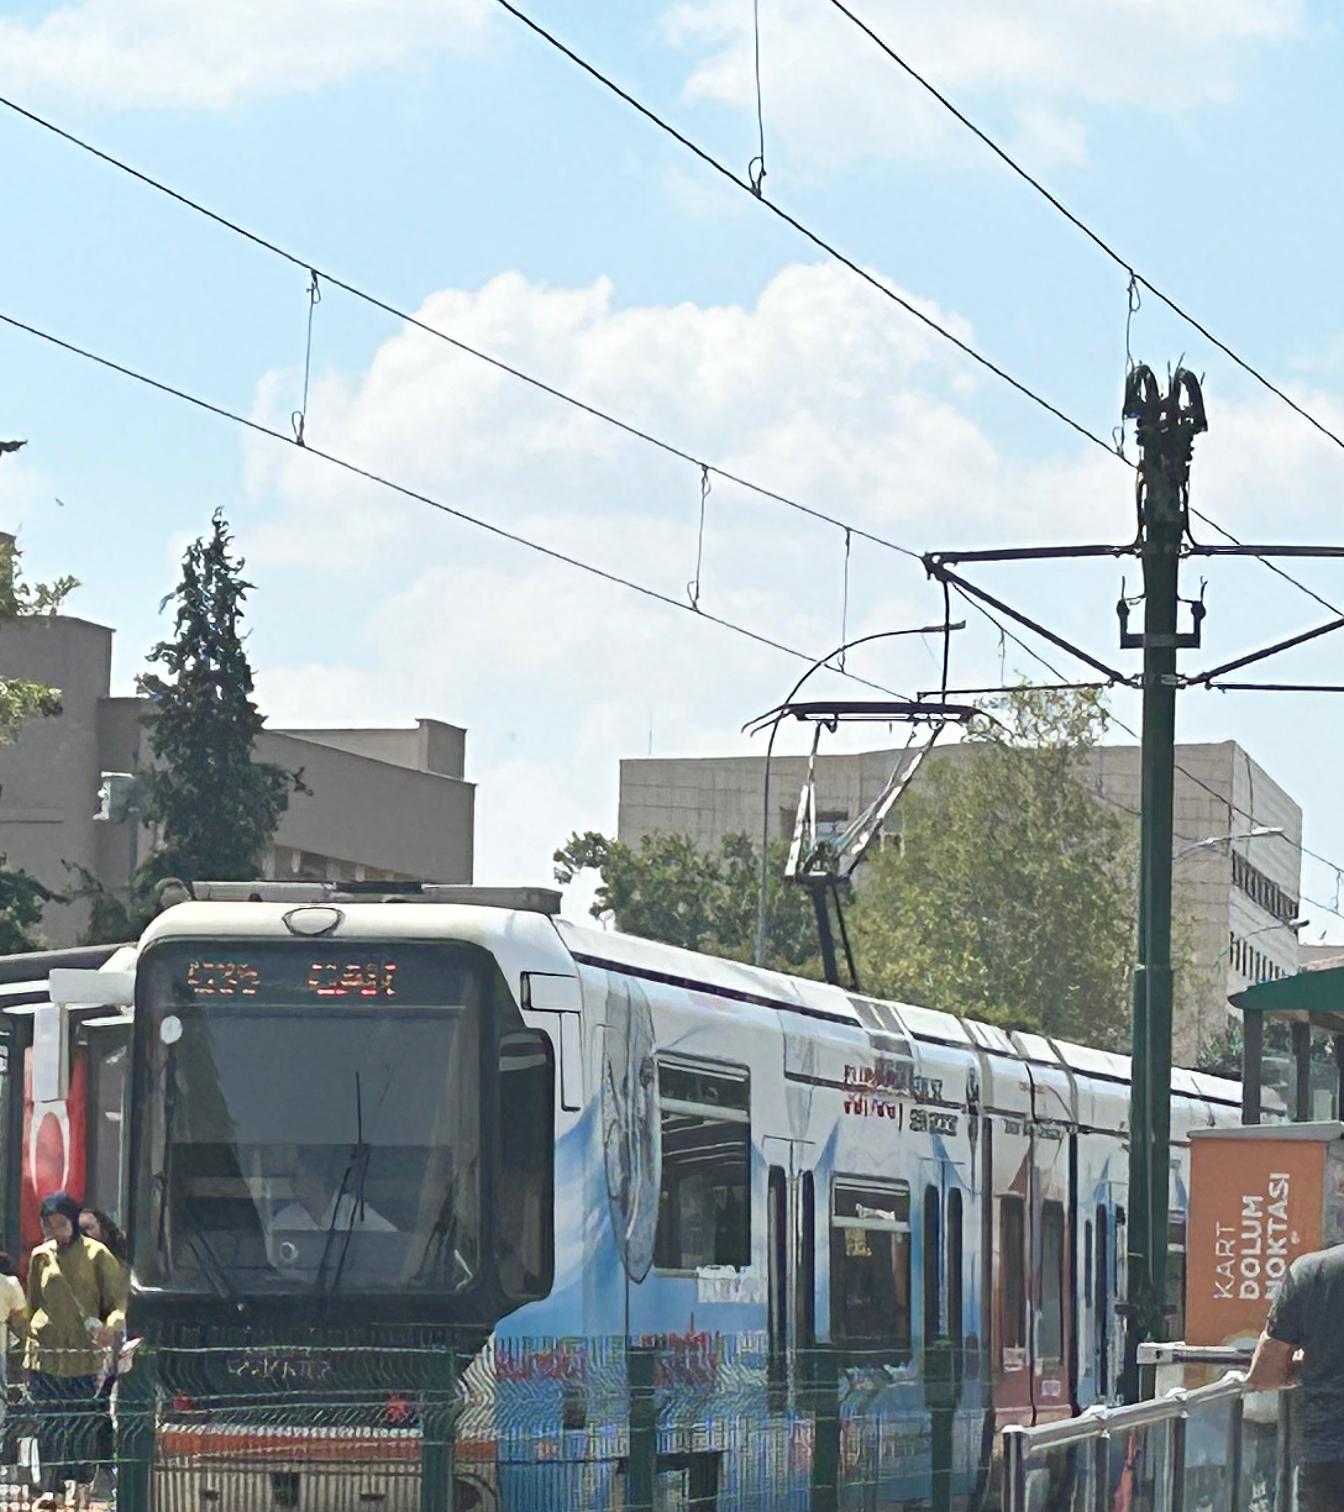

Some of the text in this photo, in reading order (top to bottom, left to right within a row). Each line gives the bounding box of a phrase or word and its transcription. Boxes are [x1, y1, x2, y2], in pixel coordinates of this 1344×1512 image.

[1213, 1220, 1236, 1299] KART
[1238, 1195, 1264, 1300] DOLUM
[1264, 1172, 1291, 1300] NOKTASI
